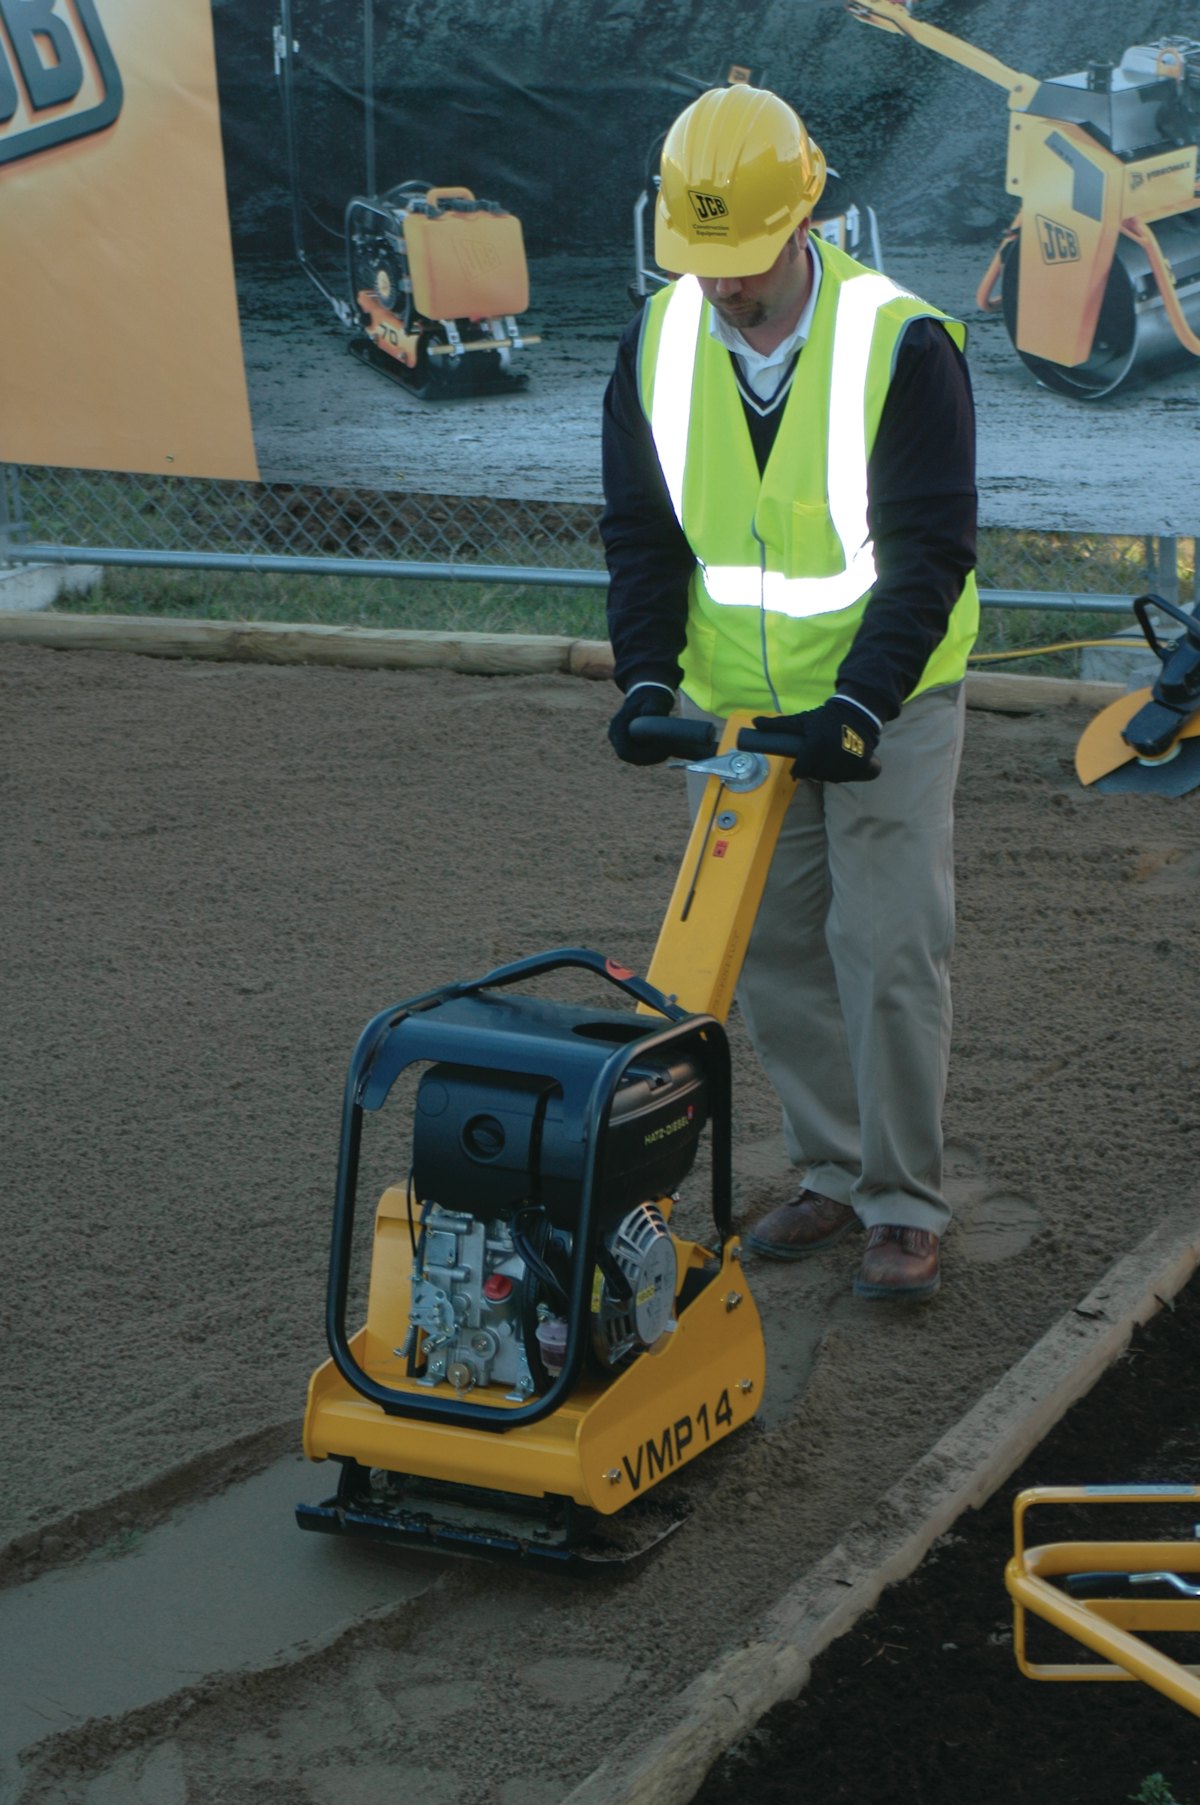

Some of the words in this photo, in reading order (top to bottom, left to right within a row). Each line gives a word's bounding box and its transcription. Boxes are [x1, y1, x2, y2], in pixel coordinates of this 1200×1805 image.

[695, 194, 726, 219] JCB
[1042, 222, 1079, 260] JCB
[379, 323, 399, 347] 70
[843, 729, 865, 755] JCB
[622, 1387, 733, 1492] VMP14
